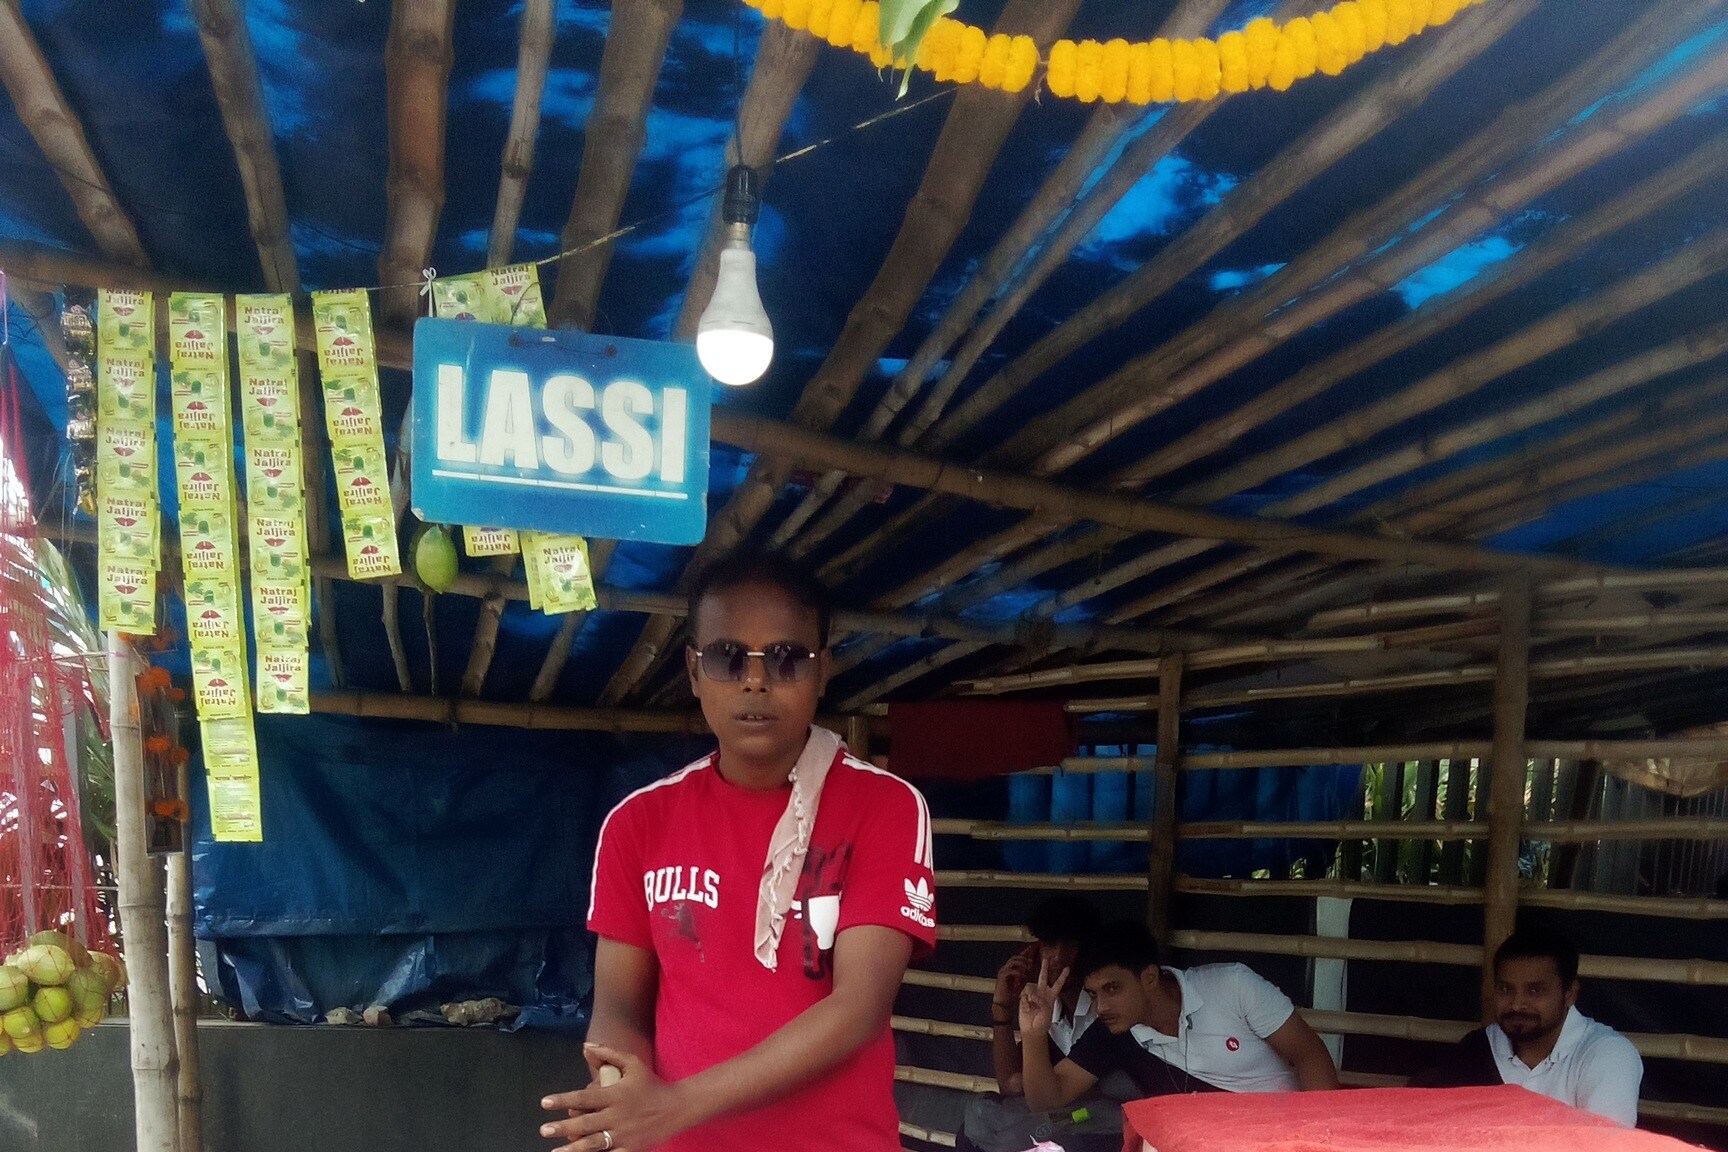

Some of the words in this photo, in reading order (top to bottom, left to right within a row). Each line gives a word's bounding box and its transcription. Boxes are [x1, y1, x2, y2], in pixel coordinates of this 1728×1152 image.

[492, 274, 531, 286] Jaljira
[106, 295, 145, 307] Jaljira
[244, 314, 285, 326] Jaljira
[177, 350, 214, 360] Natraj
[324, 348, 364, 360] Jaljira
[106, 358, 145, 369] Natraj
[326, 357, 364, 368] Natraj
[106, 366, 145, 378] Jaljira
[249, 378, 288, 388] Natraj
[249, 386, 289, 398] Jaljira
[178, 412, 216, 424] Jaljira
[332, 416, 372, 430] Jaljira
[437, 364, 688, 483] LASSI
[106, 427, 146, 438] Natraj
[179, 421, 216, 432] Natraj
[334, 427, 372, 438] Natraj
[105, 435, 146, 448] Jaljira
[254, 448, 292, 460] Natraj
[254, 457, 292, 470] Jaljira
[182, 482, 220, 494] Jaljira
[343, 486, 381, 498] Jaljira
[184, 490, 220, 502] Natraj
[346, 496, 382, 508] Natraj
[106, 497, 147, 509] Natraj
[106, 506, 148, 519] Jaljira
[256, 518, 295, 530] Natraj
[256, 527, 296, 539] Jaljira
[471, 533, 511, 544] Jaljira
[473, 542, 512, 552] Natraj
[186, 550, 224, 562] Jaljira
[352, 554, 390, 568] Jaljira
[188, 560, 225, 570] Natraj
[354, 564, 392, 576] Natraj
[108, 566, 148, 577] Natraj
[106, 574, 148, 587] Jaljira
[260, 587, 298, 598] Natraj
[260, 596, 298, 608] Jaljira
[194, 629, 230, 640] Natraj
[264, 662, 302, 675] Jaljira
[199, 686, 236, 698] Jaljira
[200, 697, 236, 708] Natraj
[644, 866, 720, 912] BULLS
